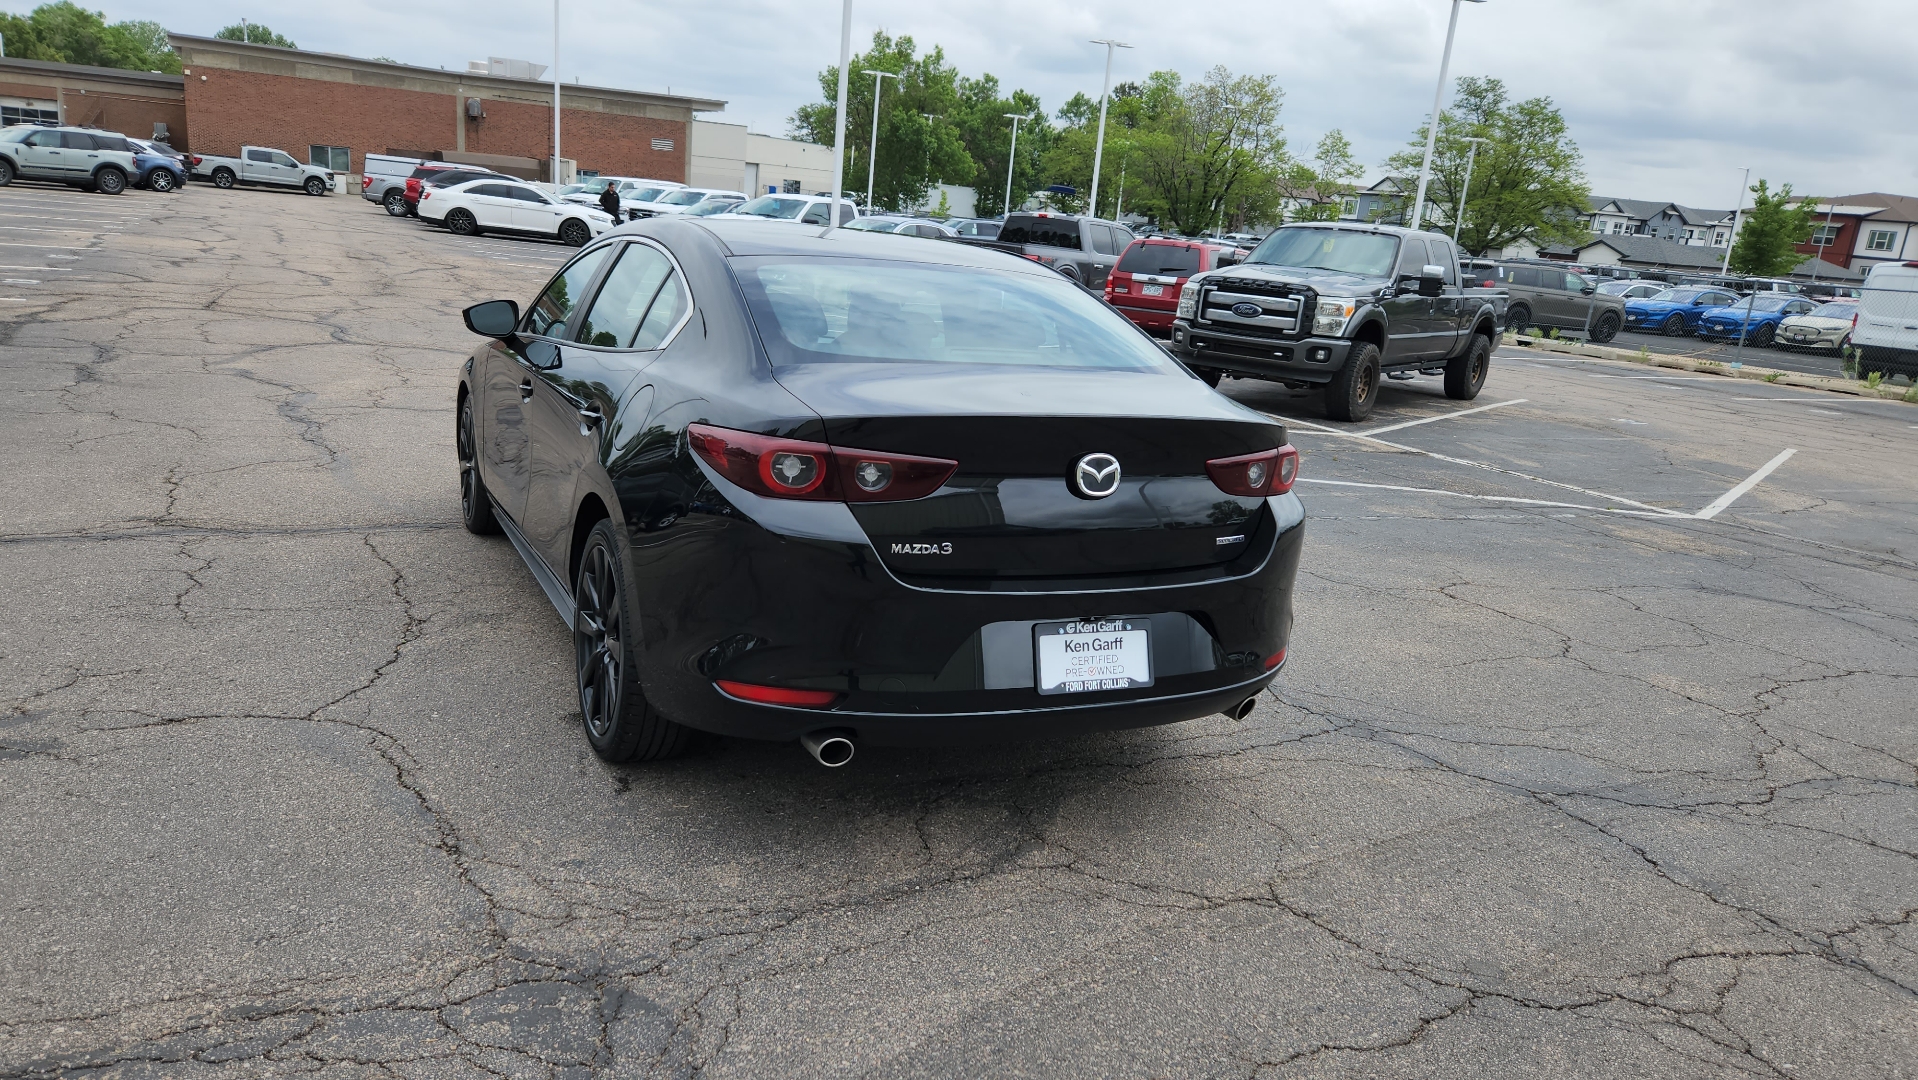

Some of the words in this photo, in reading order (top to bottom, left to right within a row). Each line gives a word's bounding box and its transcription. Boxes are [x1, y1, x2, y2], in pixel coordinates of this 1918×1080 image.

[1076, 621, 1097, 633] Ken
[1097, 620, 1124, 632] Garff
[1065, 639, 1090, 653] Ken
[1092, 637, 1124, 652] Garff
[1071, 654, 1119, 667] CERTIFIED
[1066, 681, 1084, 692] FORD
[1084, 680, 1101, 691] FORT
[1101, 678, 1129, 690] COLLINS
